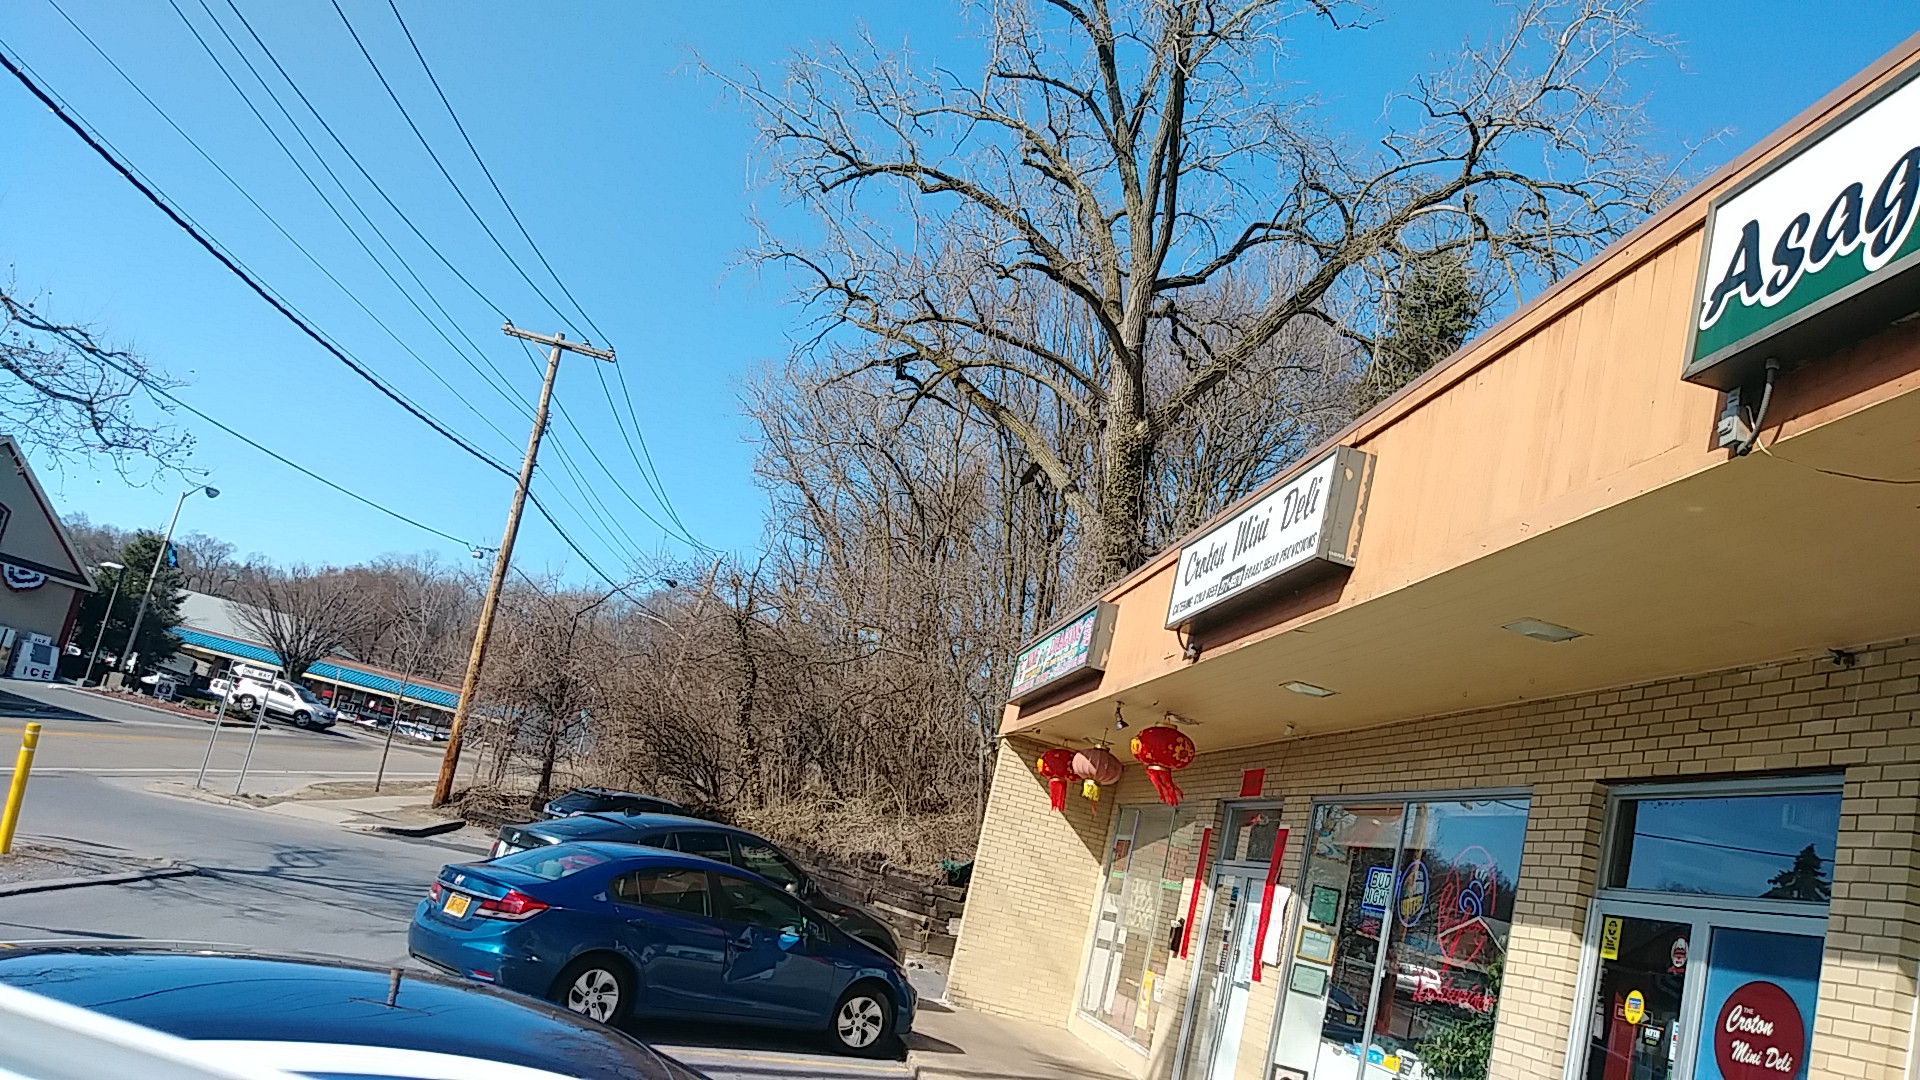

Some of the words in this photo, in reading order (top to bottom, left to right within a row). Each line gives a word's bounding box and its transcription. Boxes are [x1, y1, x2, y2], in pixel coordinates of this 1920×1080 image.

[1184, 542, 1228, 587] Croton
[1232, 506, 1273, 562] Mini
[1281, 476, 1324, 533] Deli
[23, 665, 51, 680] ICE
[258, 671, 271, 679] WAY
[1370, 871, 1392, 889] BUD
[1743, 1007, 1754, 1015] THE
[1725, 1004, 1774, 1037] Croton
[1731, 1039, 1763, 1066] Mini
[1764, 1046, 1793, 1072] Deli
